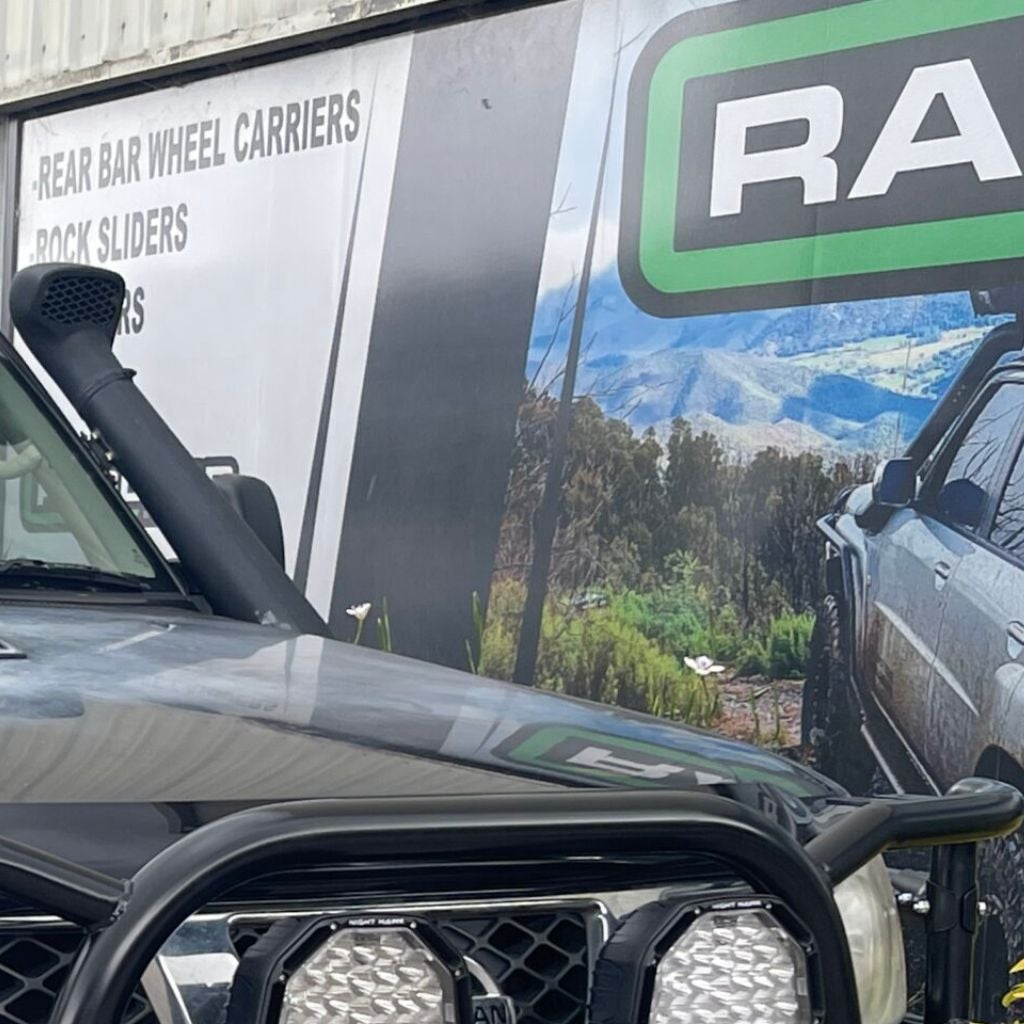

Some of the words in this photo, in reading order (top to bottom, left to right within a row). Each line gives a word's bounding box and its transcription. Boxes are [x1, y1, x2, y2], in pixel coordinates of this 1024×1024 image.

[98, 135, 142, 189] BAR
[148, 117, 226, 180] WHEEL
[234, 88, 361, 164] CARRIERS
[97, 202, 189, 264] SLIDERS
